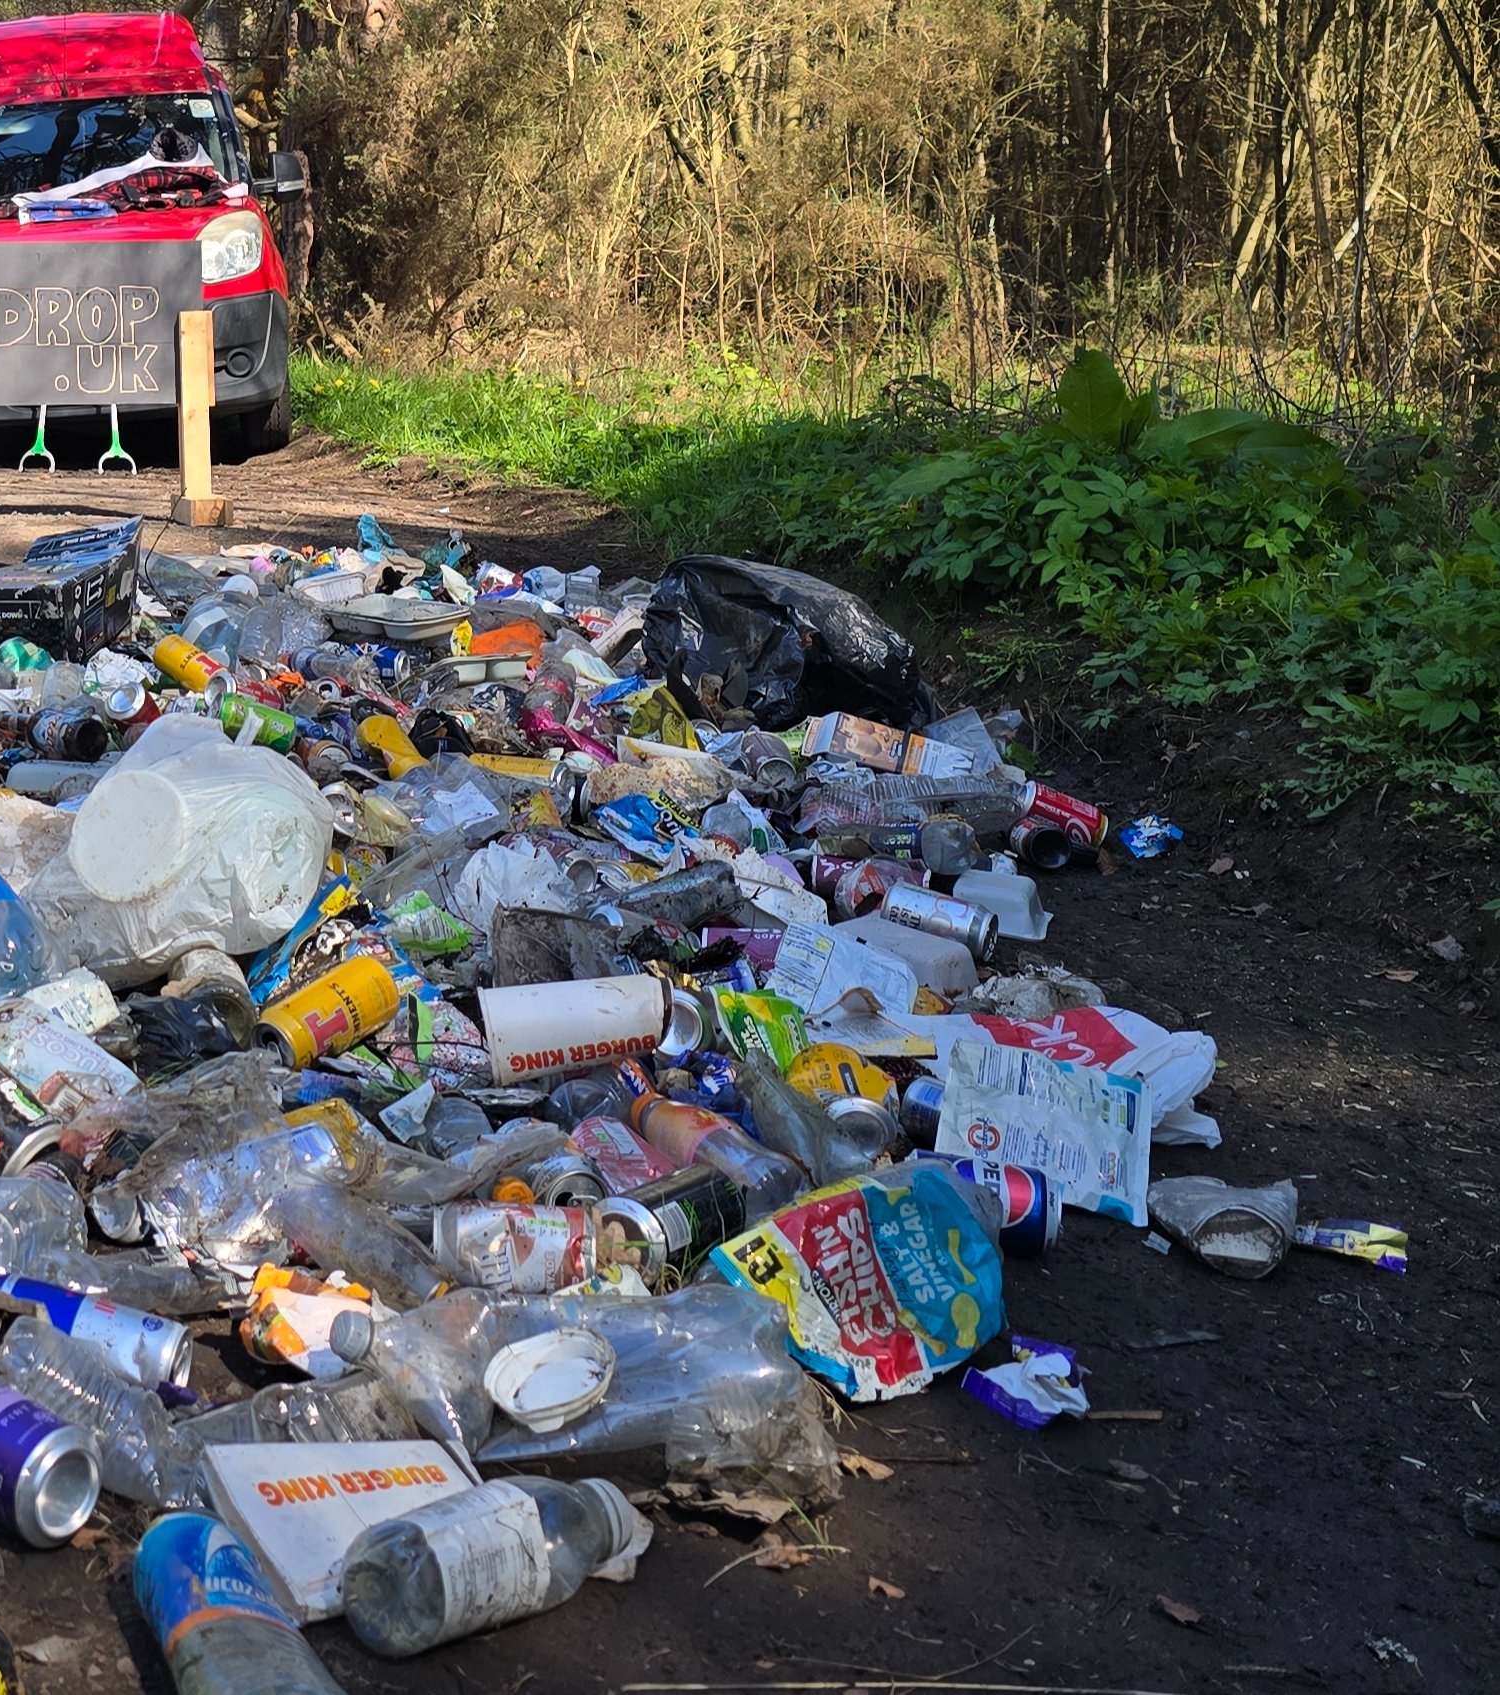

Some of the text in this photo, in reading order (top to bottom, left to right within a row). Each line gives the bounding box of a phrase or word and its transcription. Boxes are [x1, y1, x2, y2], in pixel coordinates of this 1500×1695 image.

[54, 344, 159, 394] .UK
[1, 610, 23, 619] DOWN
[510, 1034, 657, 1073] BURGER KING
[837, 1207, 897, 1336] CHIPS
[879, 1221, 937, 1304] SALT &
[900, 1202, 956, 1302] VINEGAR
[811, 1268, 843, 1324] URTON'S
[258, 1465, 449, 1507] BURGER KING
